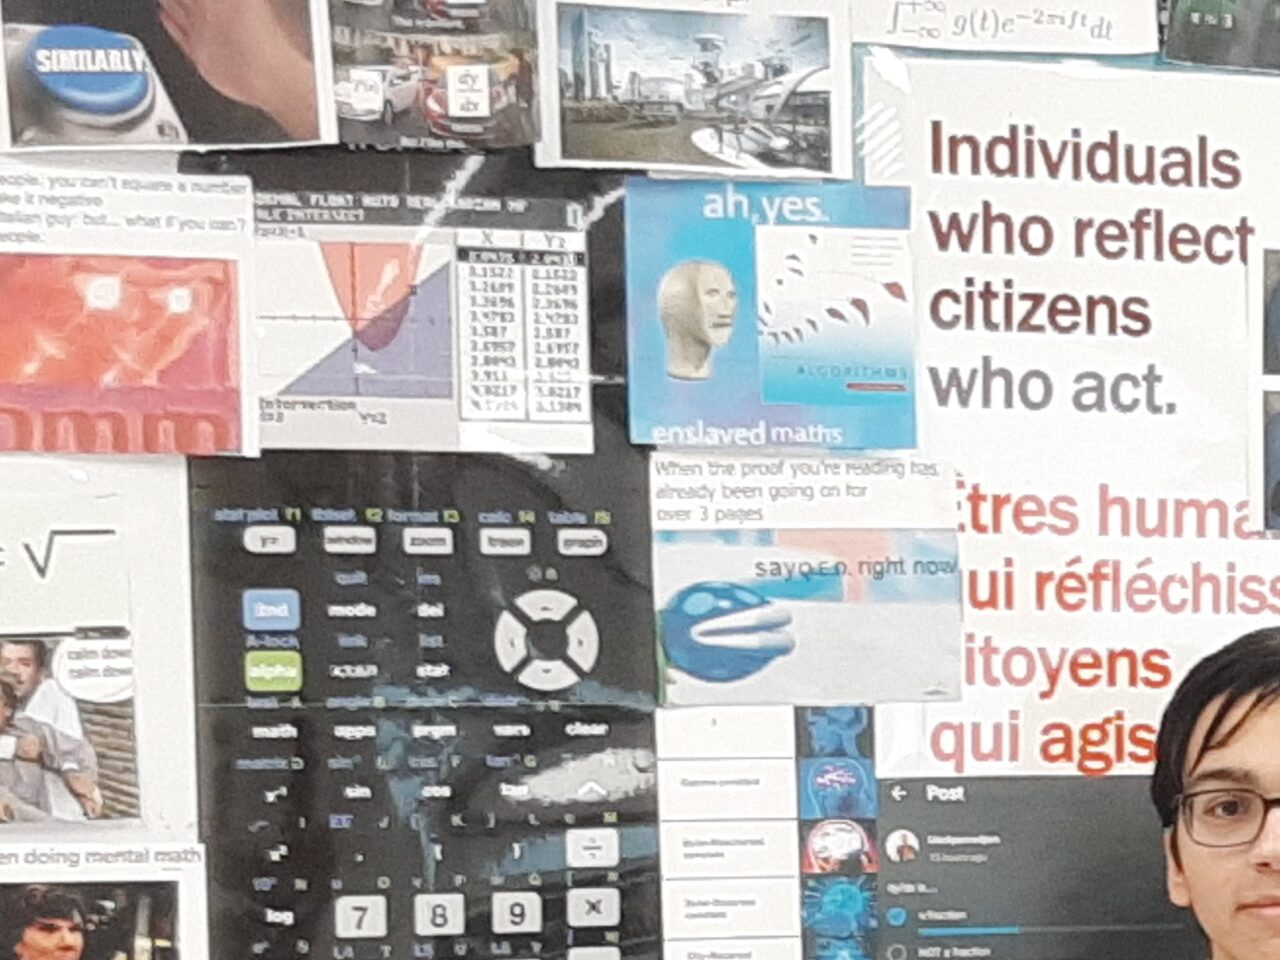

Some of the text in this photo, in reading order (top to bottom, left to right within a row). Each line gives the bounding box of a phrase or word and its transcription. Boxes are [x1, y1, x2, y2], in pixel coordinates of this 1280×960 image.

[930, 119, 1242, 189] Individuals
[927, 200, 1255, 266] who reflect
[929, 276, 1152, 338] citizens
[927, 355, 1177, 415] who act.
[651, 419, 844, 445] enslaved maths
[656, 484, 716, 503] already
[768, 485, 815, 502] going
[741, 460, 784, 478] proof
[846, 461, 905, 478] reading
[700, 507, 709, 522] 3
[715, 507, 764, 525] pages
[956, 468, 1080, 536] tres
[967, 556, 1015, 611] ui
[964, 631, 1173, 700] itoyens
[929, 709, 1158, 777] qui agis
[926, 784, 965, 801] Post
[23, 847, 80, 868] doing
[85, 848, 150, 865] mental
[351, 901, 526, 930] 7 8 9
